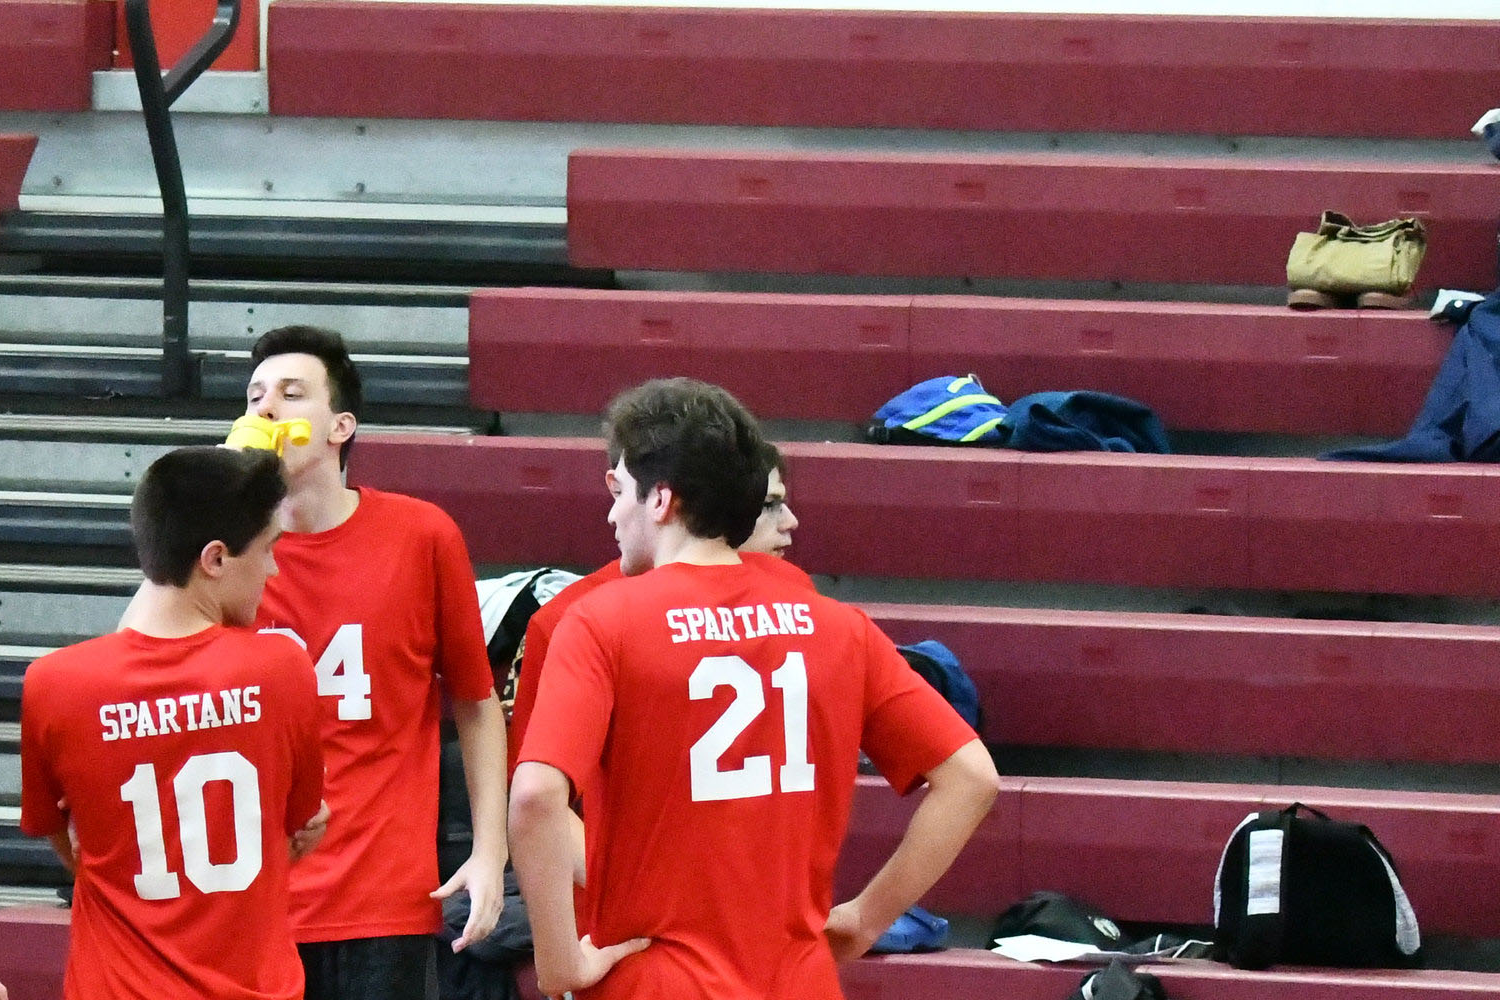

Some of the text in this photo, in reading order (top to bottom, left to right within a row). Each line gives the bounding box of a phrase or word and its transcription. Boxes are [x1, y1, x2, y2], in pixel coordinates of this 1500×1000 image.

[666, 603, 814, 643] SPARTANS
[99, 685, 261, 741] SPARTANS
[688, 651, 815, 802] 21
[120, 751, 262, 900] 10
